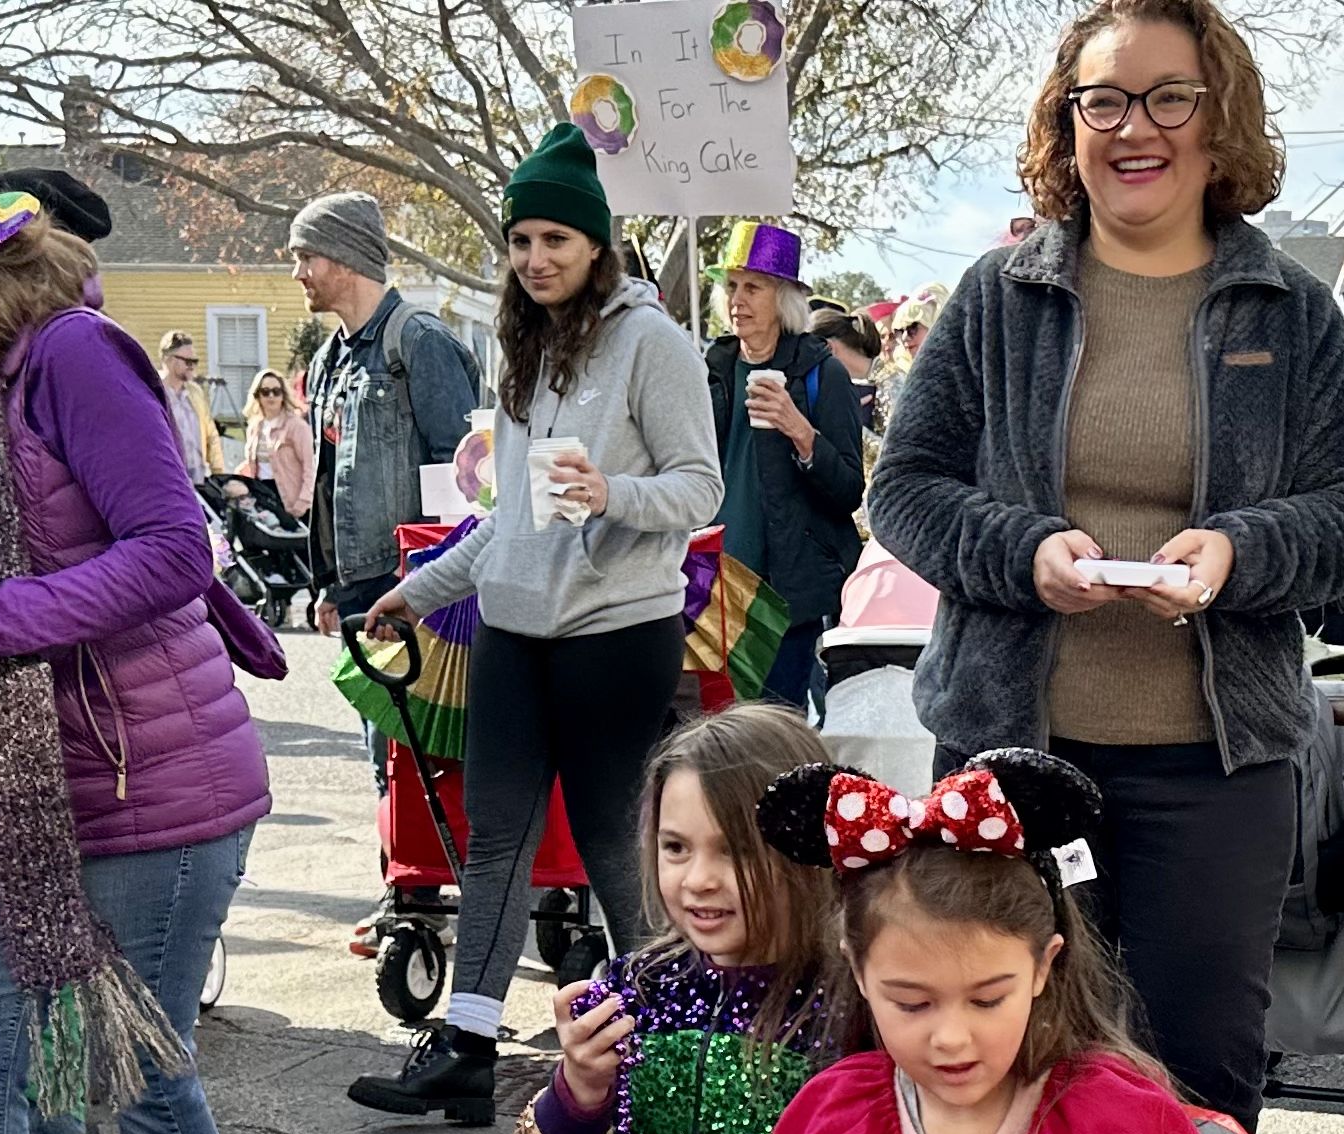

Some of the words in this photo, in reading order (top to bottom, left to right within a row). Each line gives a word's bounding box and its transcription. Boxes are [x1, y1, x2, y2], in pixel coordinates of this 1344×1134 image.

[604, 33, 643, 66] In
[671, 28, 699, 62] It
[658, 87, 695, 121] For
[709, 81, 752, 114] The
[641, 140, 692, 184] King
[699, 137, 760, 174] Cake
